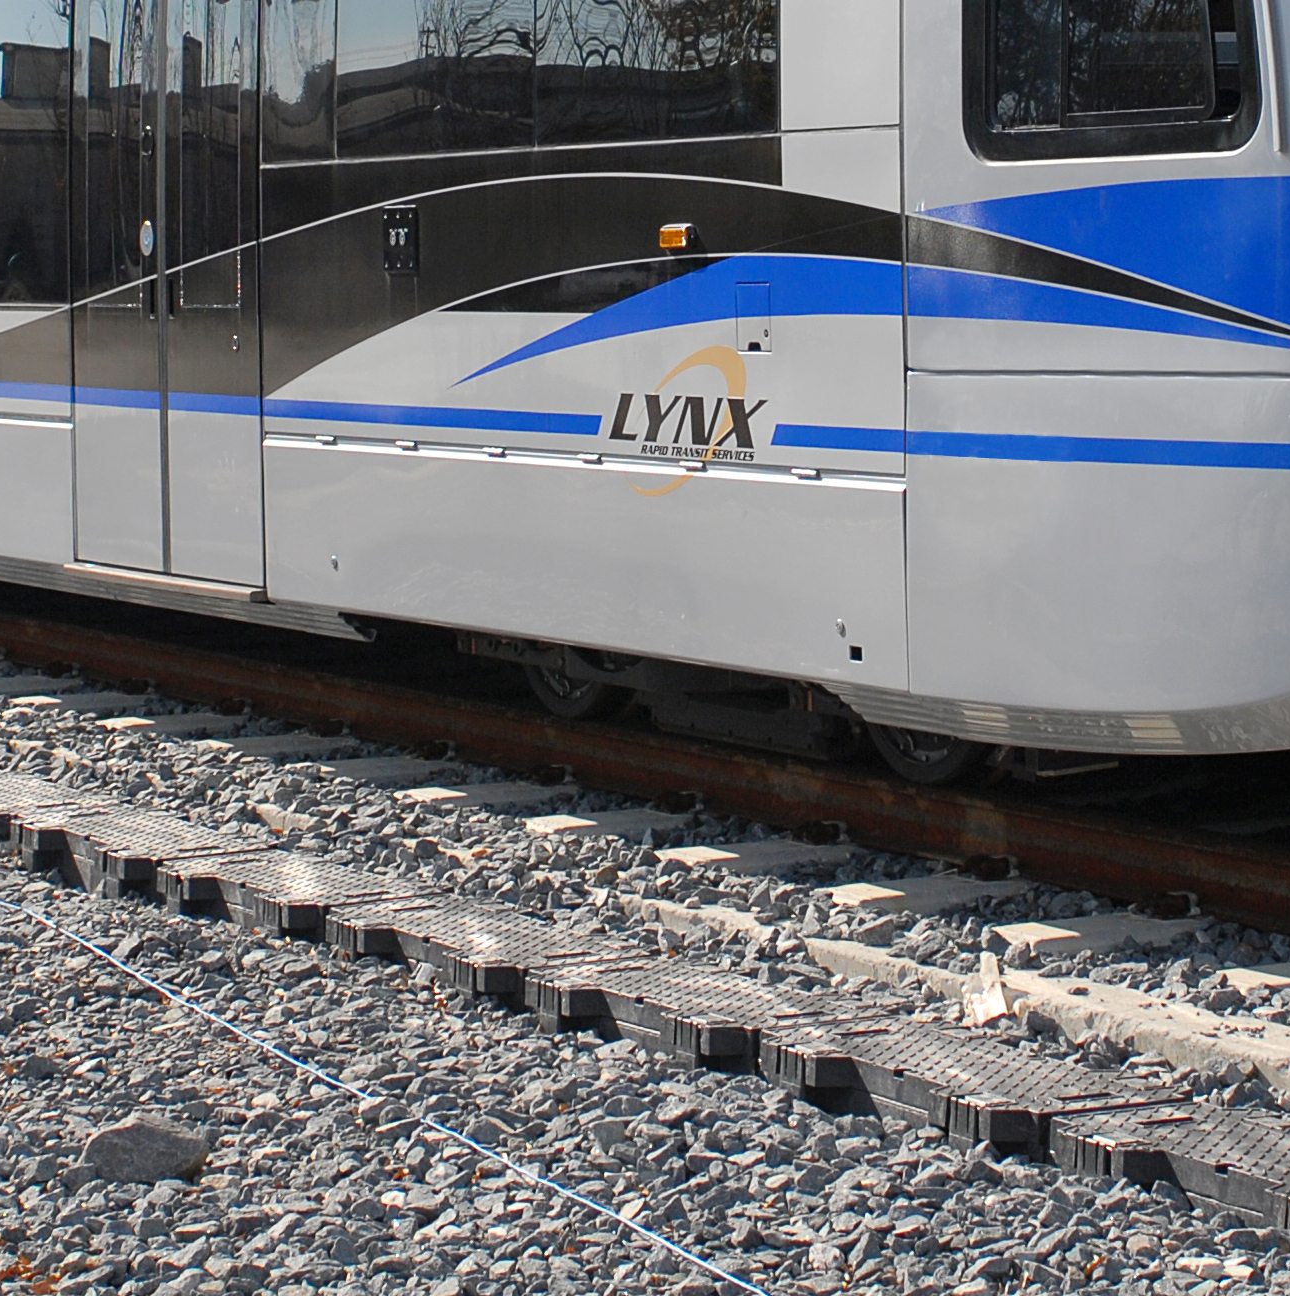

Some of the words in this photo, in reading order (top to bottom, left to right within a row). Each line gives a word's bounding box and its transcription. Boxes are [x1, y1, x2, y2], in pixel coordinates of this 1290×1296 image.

[609, 392, 769, 449] LYNX
[641, 444, 668, 456] RAPID
[671, 446, 710, 459] TRANSIT
[711, 448, 755, 461] SERVICES
